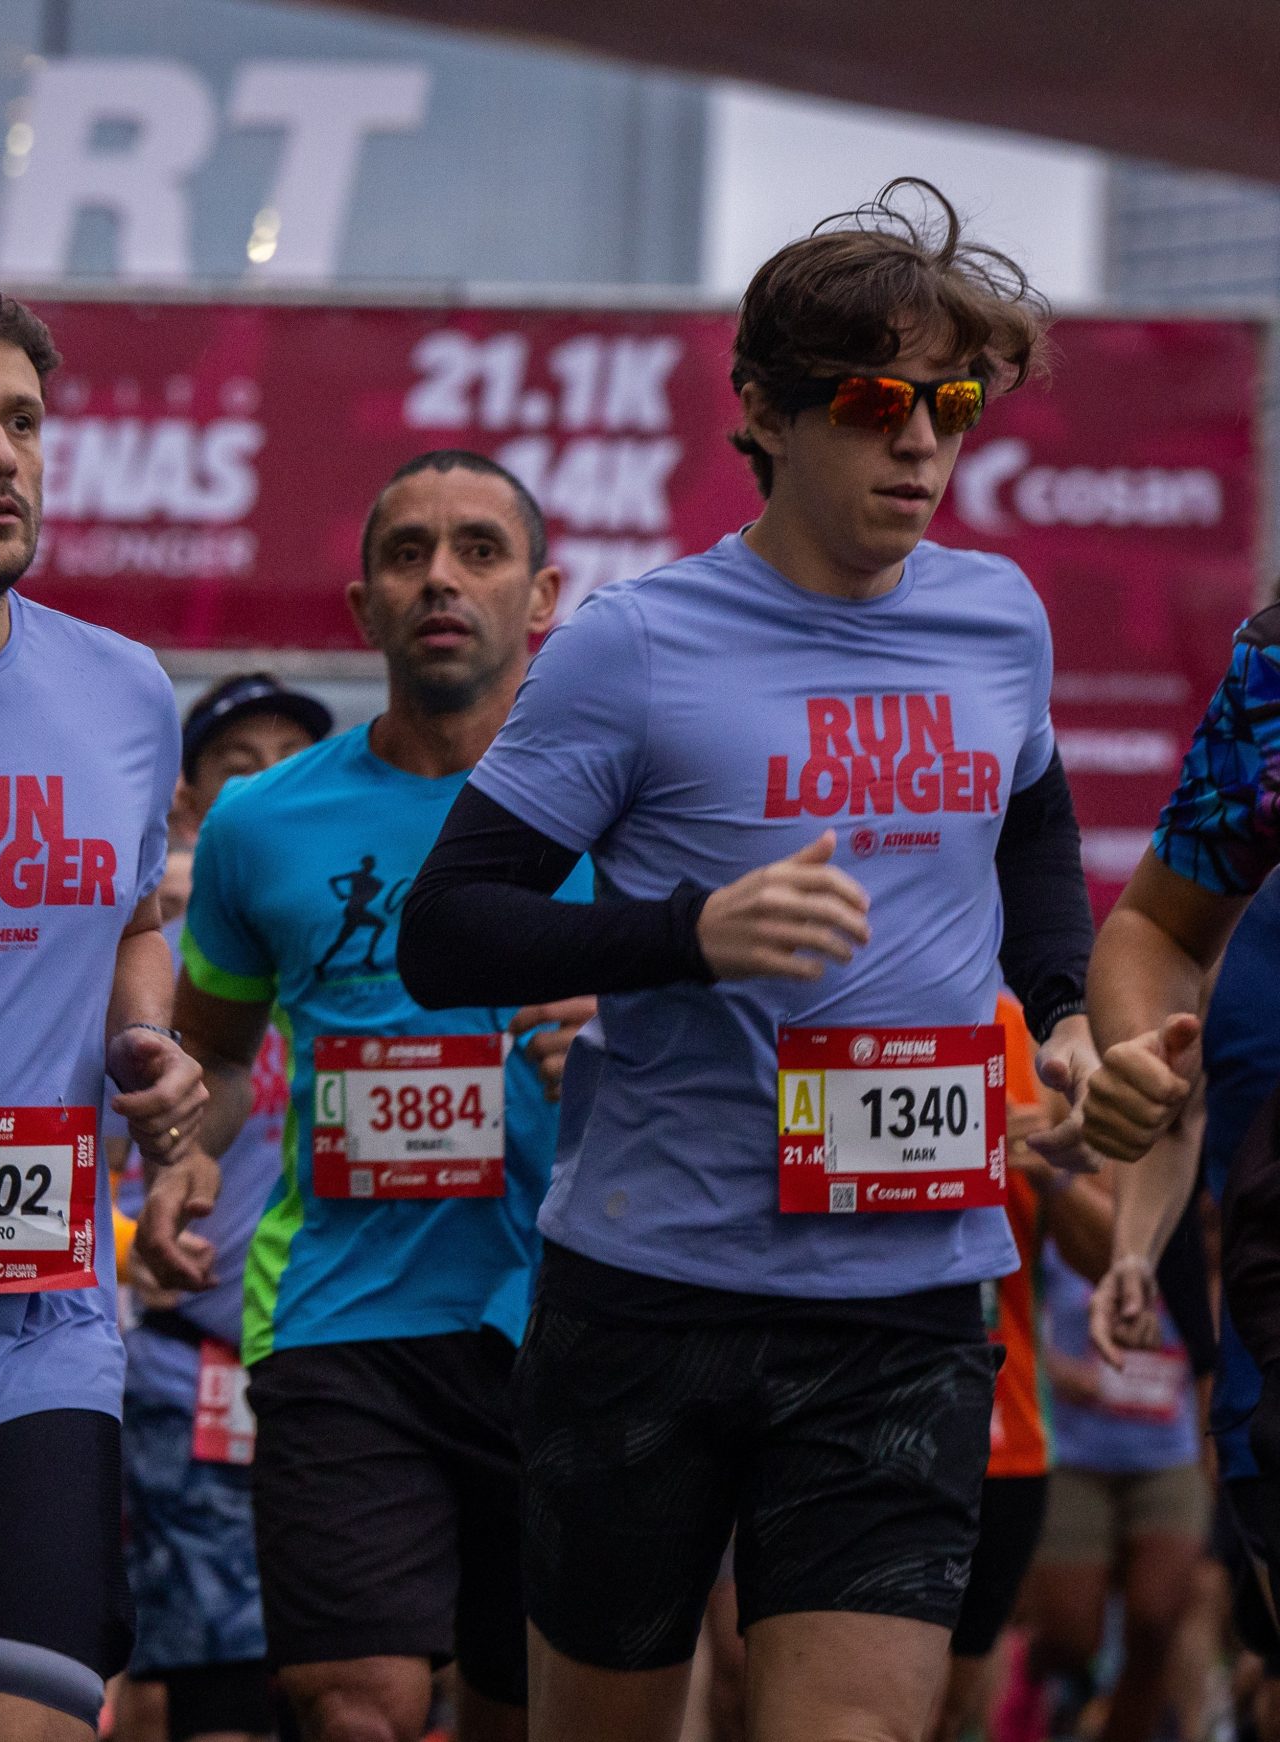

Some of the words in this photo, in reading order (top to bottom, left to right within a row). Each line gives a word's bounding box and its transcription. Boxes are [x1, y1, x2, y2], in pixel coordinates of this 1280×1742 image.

[404, 331, 682, 431] 21.1K
[41, 417, 265, 522] ENAS
[806, 694, 955, 757] RUN
[763, 750, 1001, 819] LONGER
[882, 1039, 938, 1056] ATHENAS
[322, 1079, 337, 1119] C
[369, 1083, 486, 1133] 3884
[791, 1079, 814, 1125] A
[860, 1084, 968, 1139] 1340
[77, 1134, 88, 1168] 2402
[902, 1147, 937, 1163] MARK
[877, 1187, 917, 1200] cosan
[73, 1230, 87, 1263] 2402
